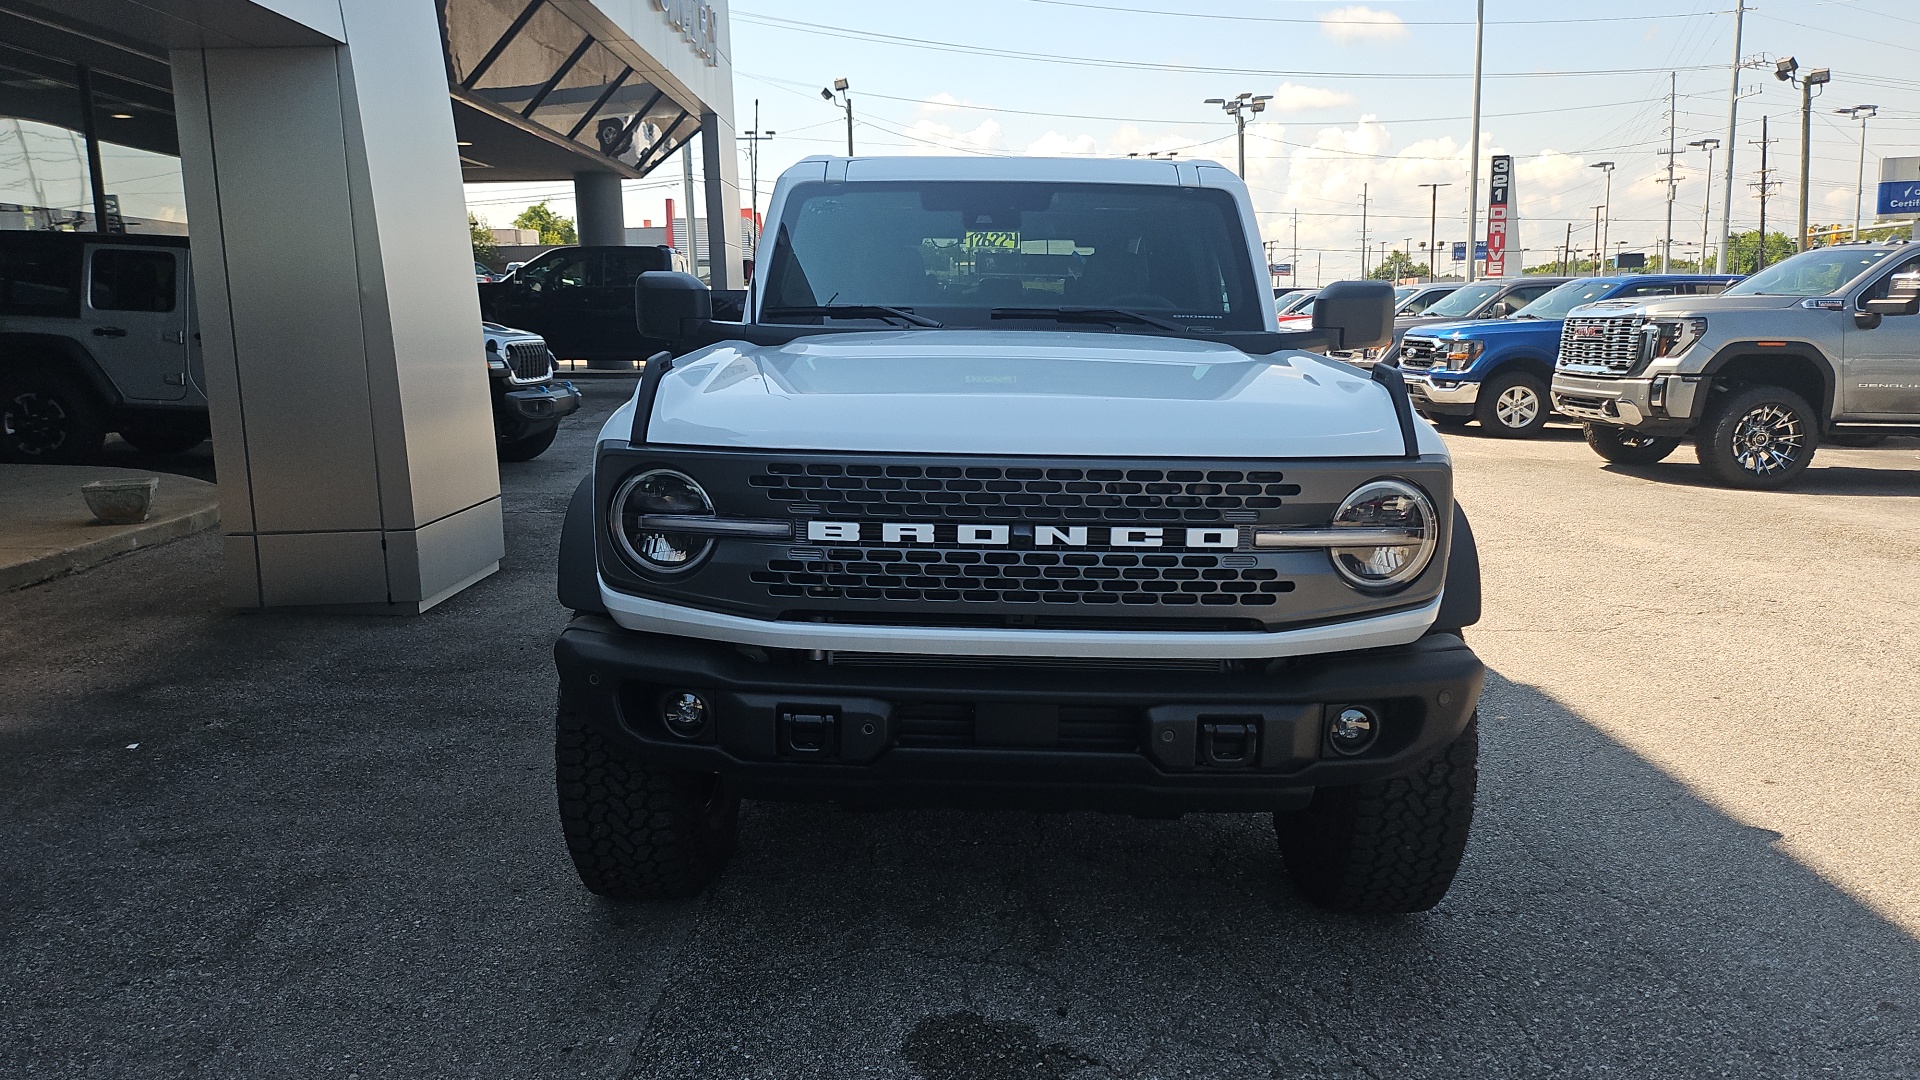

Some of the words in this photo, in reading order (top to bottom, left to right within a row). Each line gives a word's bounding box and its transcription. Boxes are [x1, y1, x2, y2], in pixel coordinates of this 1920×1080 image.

[1493, 159, 1508, 201] 321
[1488, 207, 1507, 274] DRIVE
[807, 521, 1239, 547] BRONCO
